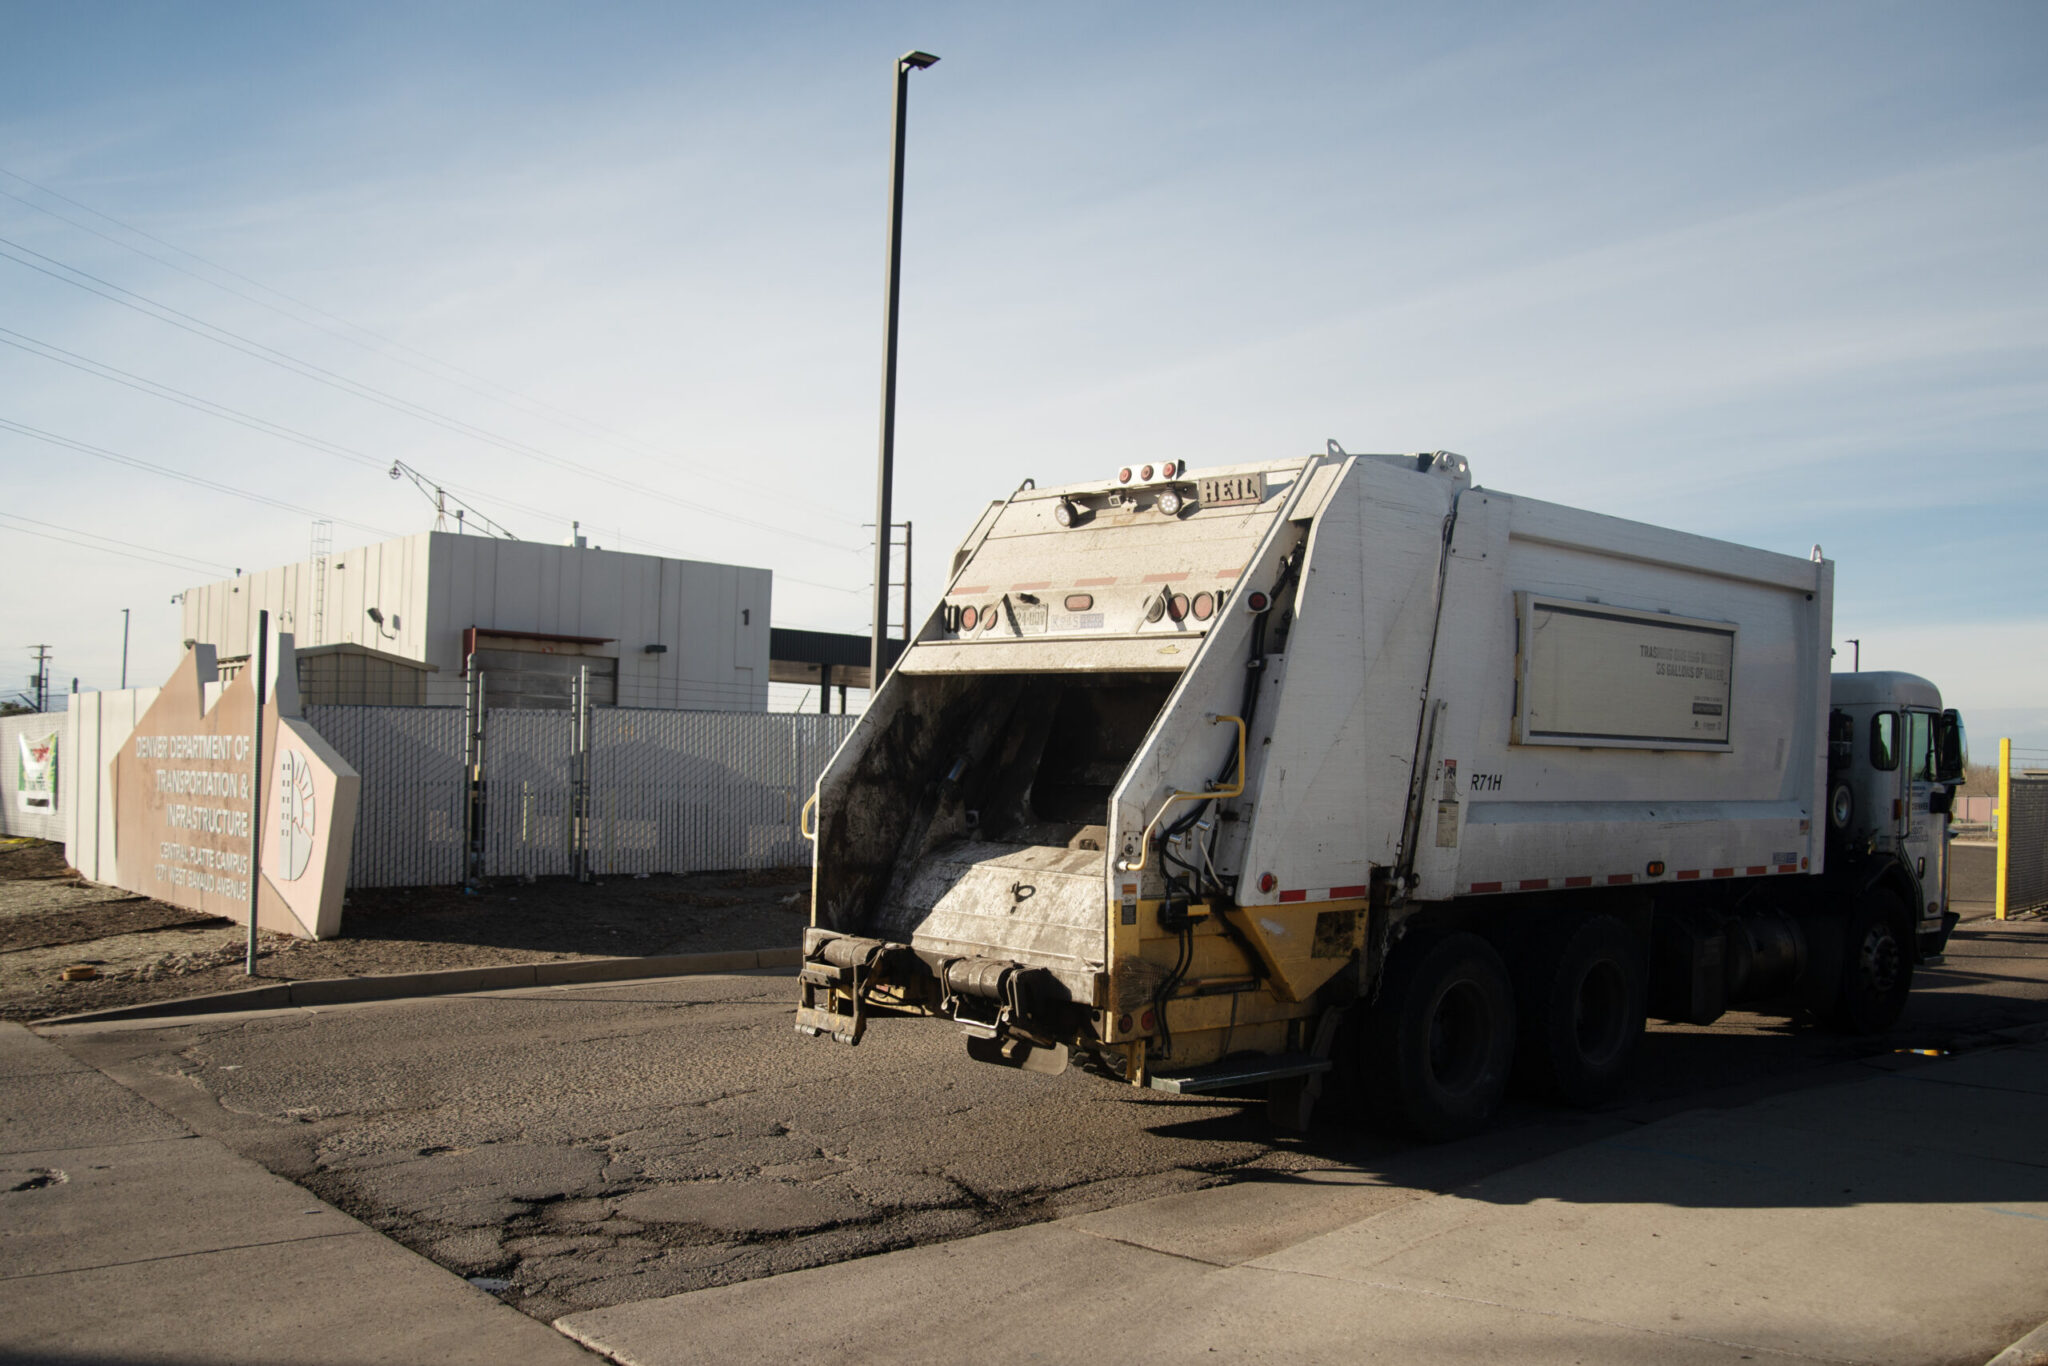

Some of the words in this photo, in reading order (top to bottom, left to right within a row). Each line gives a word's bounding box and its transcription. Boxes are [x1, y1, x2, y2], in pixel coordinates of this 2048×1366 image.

[1203, 478, 1259, 503] HEIL
[741, 608, 750, 626] 1
[136, 736, 168, 758] DENVER
[170, 735, 232, 760] DEPARTMENT
[234, 735, 250, 761] OF
[156, 769, 238, 798] TRANSPORTATION
[241, 773, 249, 800] &
[1470, 774, 1503, 791] R71H
[167, 804, 248, 837] INFRASTRUCTURE
[160, 842, 188, 863] CENTRAL
[189, 846, 215, 867] PLATTE
[216, 851, 248, 875] CAMPUS
[169, 866, 187, 886] WEST
[216, 877, 247, 901] AVENUE
